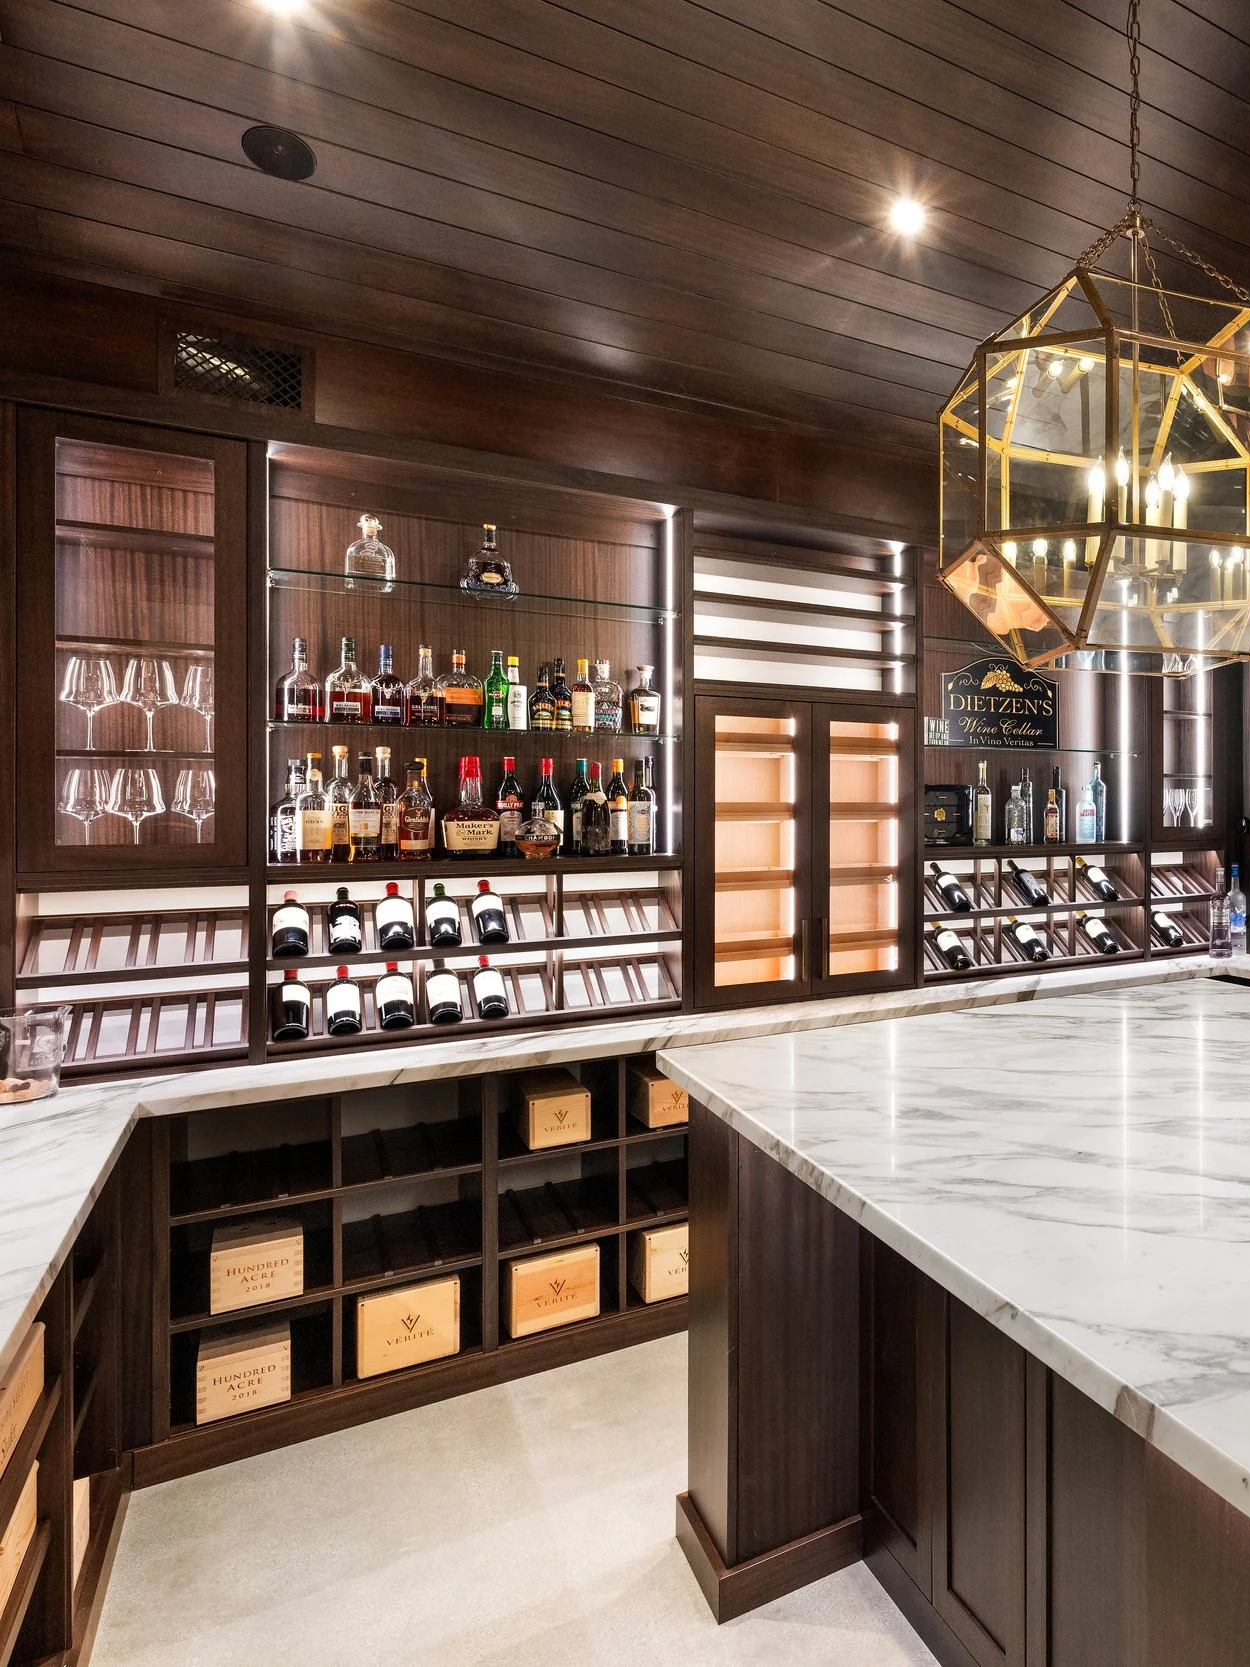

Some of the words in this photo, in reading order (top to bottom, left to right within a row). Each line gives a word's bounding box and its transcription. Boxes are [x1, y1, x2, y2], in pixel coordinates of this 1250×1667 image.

[950, 694, 1052, 716] DIETZEN'S
[929, 719, 950, 733] WINE
[958, 717, 998, 734] Wine
[1000, 719, 1042, 736] Cellar
[980, 735, 1002, 746] Vino
[1004, 737, 1034, 747] Veritas
[226, 1258, 289, 1277] HUNDRED
[240, 1270, 276, 1284] ACRE
[245, 1282, 271, 1292] 2018
[212, 1364, 276, 1386] HUNDRED
[226, 1376, 264, 1392] ACRE
[232, 1389, 258, 1400] 2018
